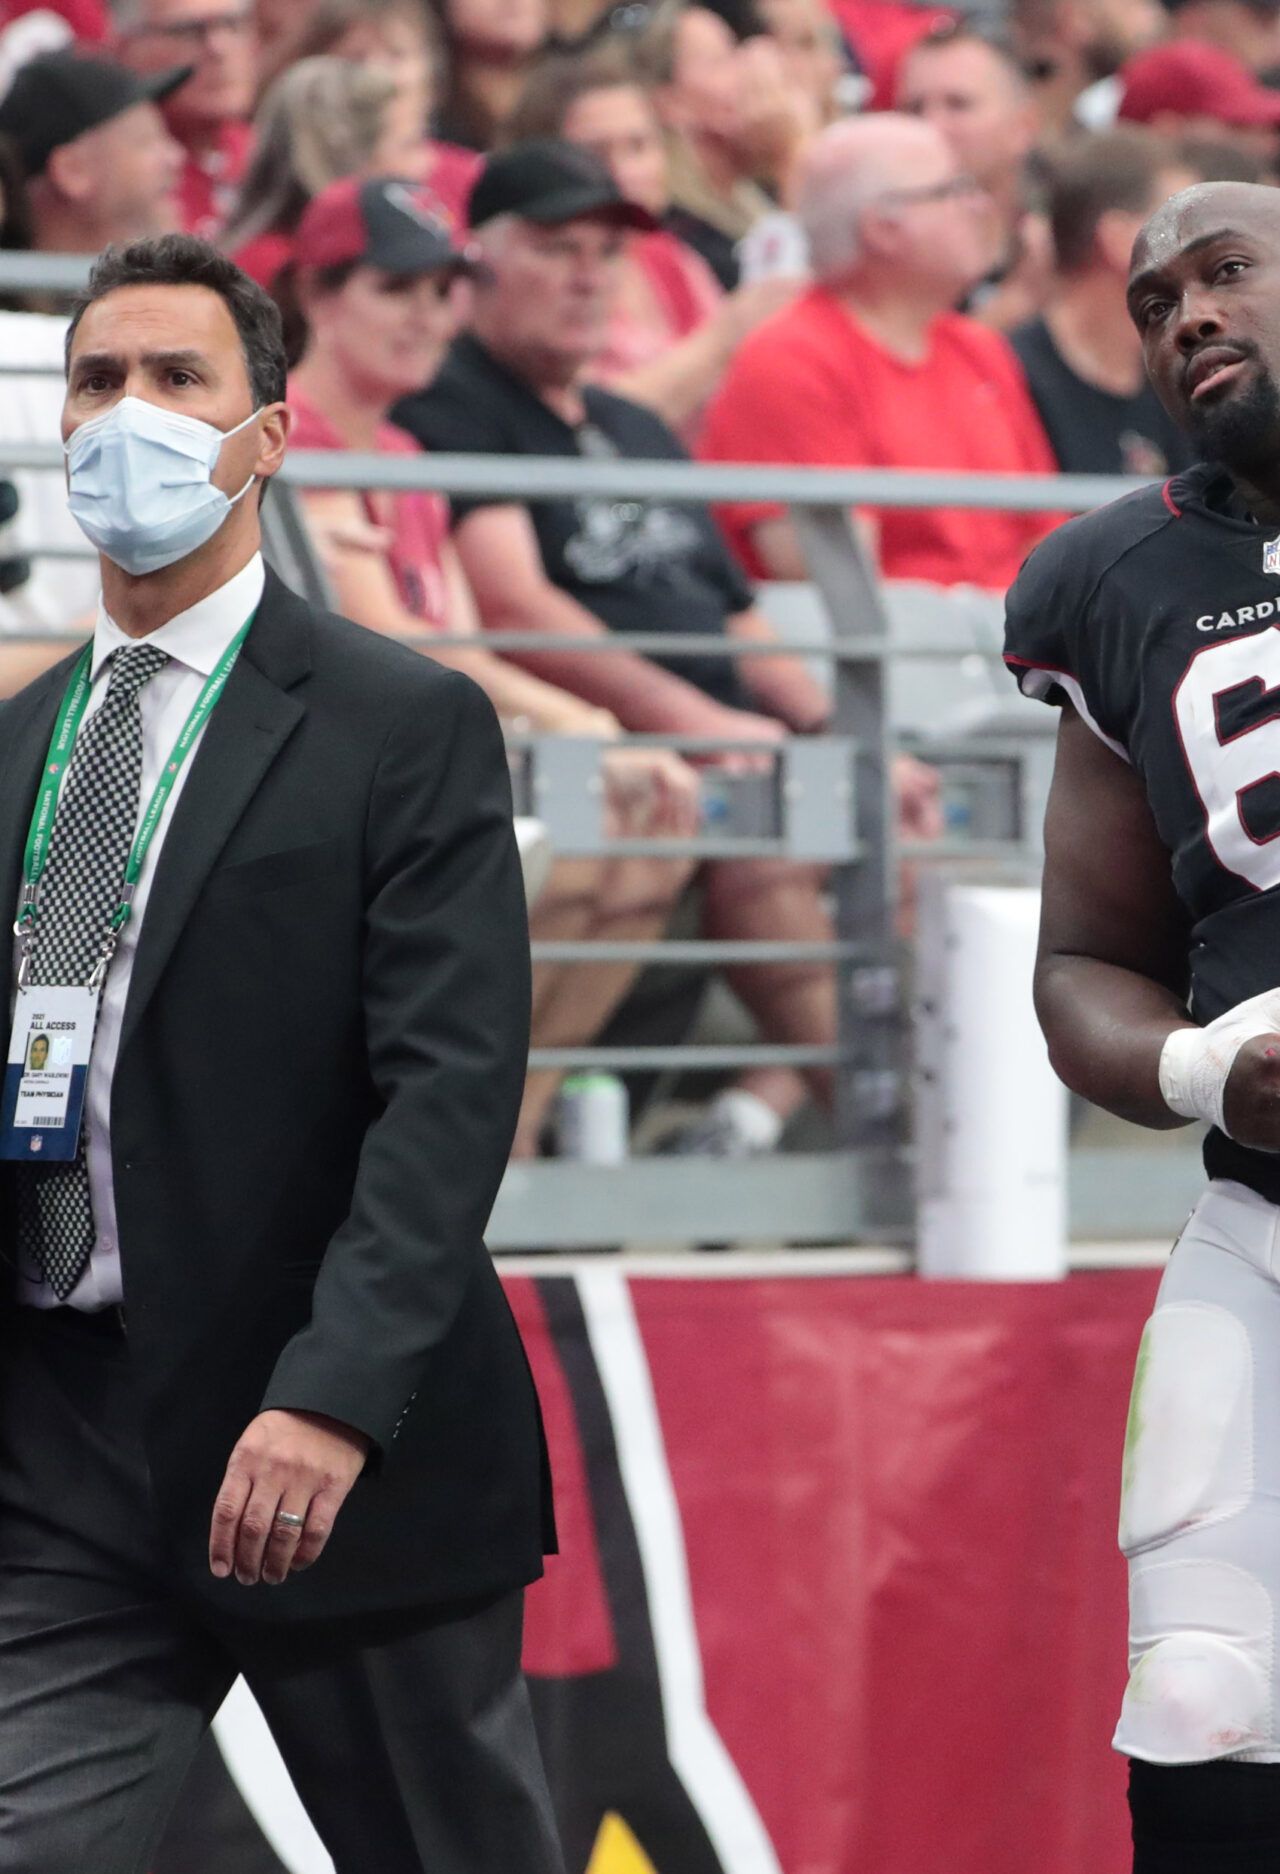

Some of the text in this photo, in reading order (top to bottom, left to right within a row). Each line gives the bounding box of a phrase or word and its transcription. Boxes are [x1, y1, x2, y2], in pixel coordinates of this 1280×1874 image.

[56, 680, 86, 750] FOOTBALL LEAGUE
[180, 709, 204, 748] NATIONAL
[200, 673, 227, 709] FOOTBALL
[37, 790, 52, 831] NATIONAL
[135, 786, 166, 864] FOOTBALL LEAGUE
[31, 833, 44, 878] FOOTBALL
[30, 1021, 76, 1030] ALL ACCESS
